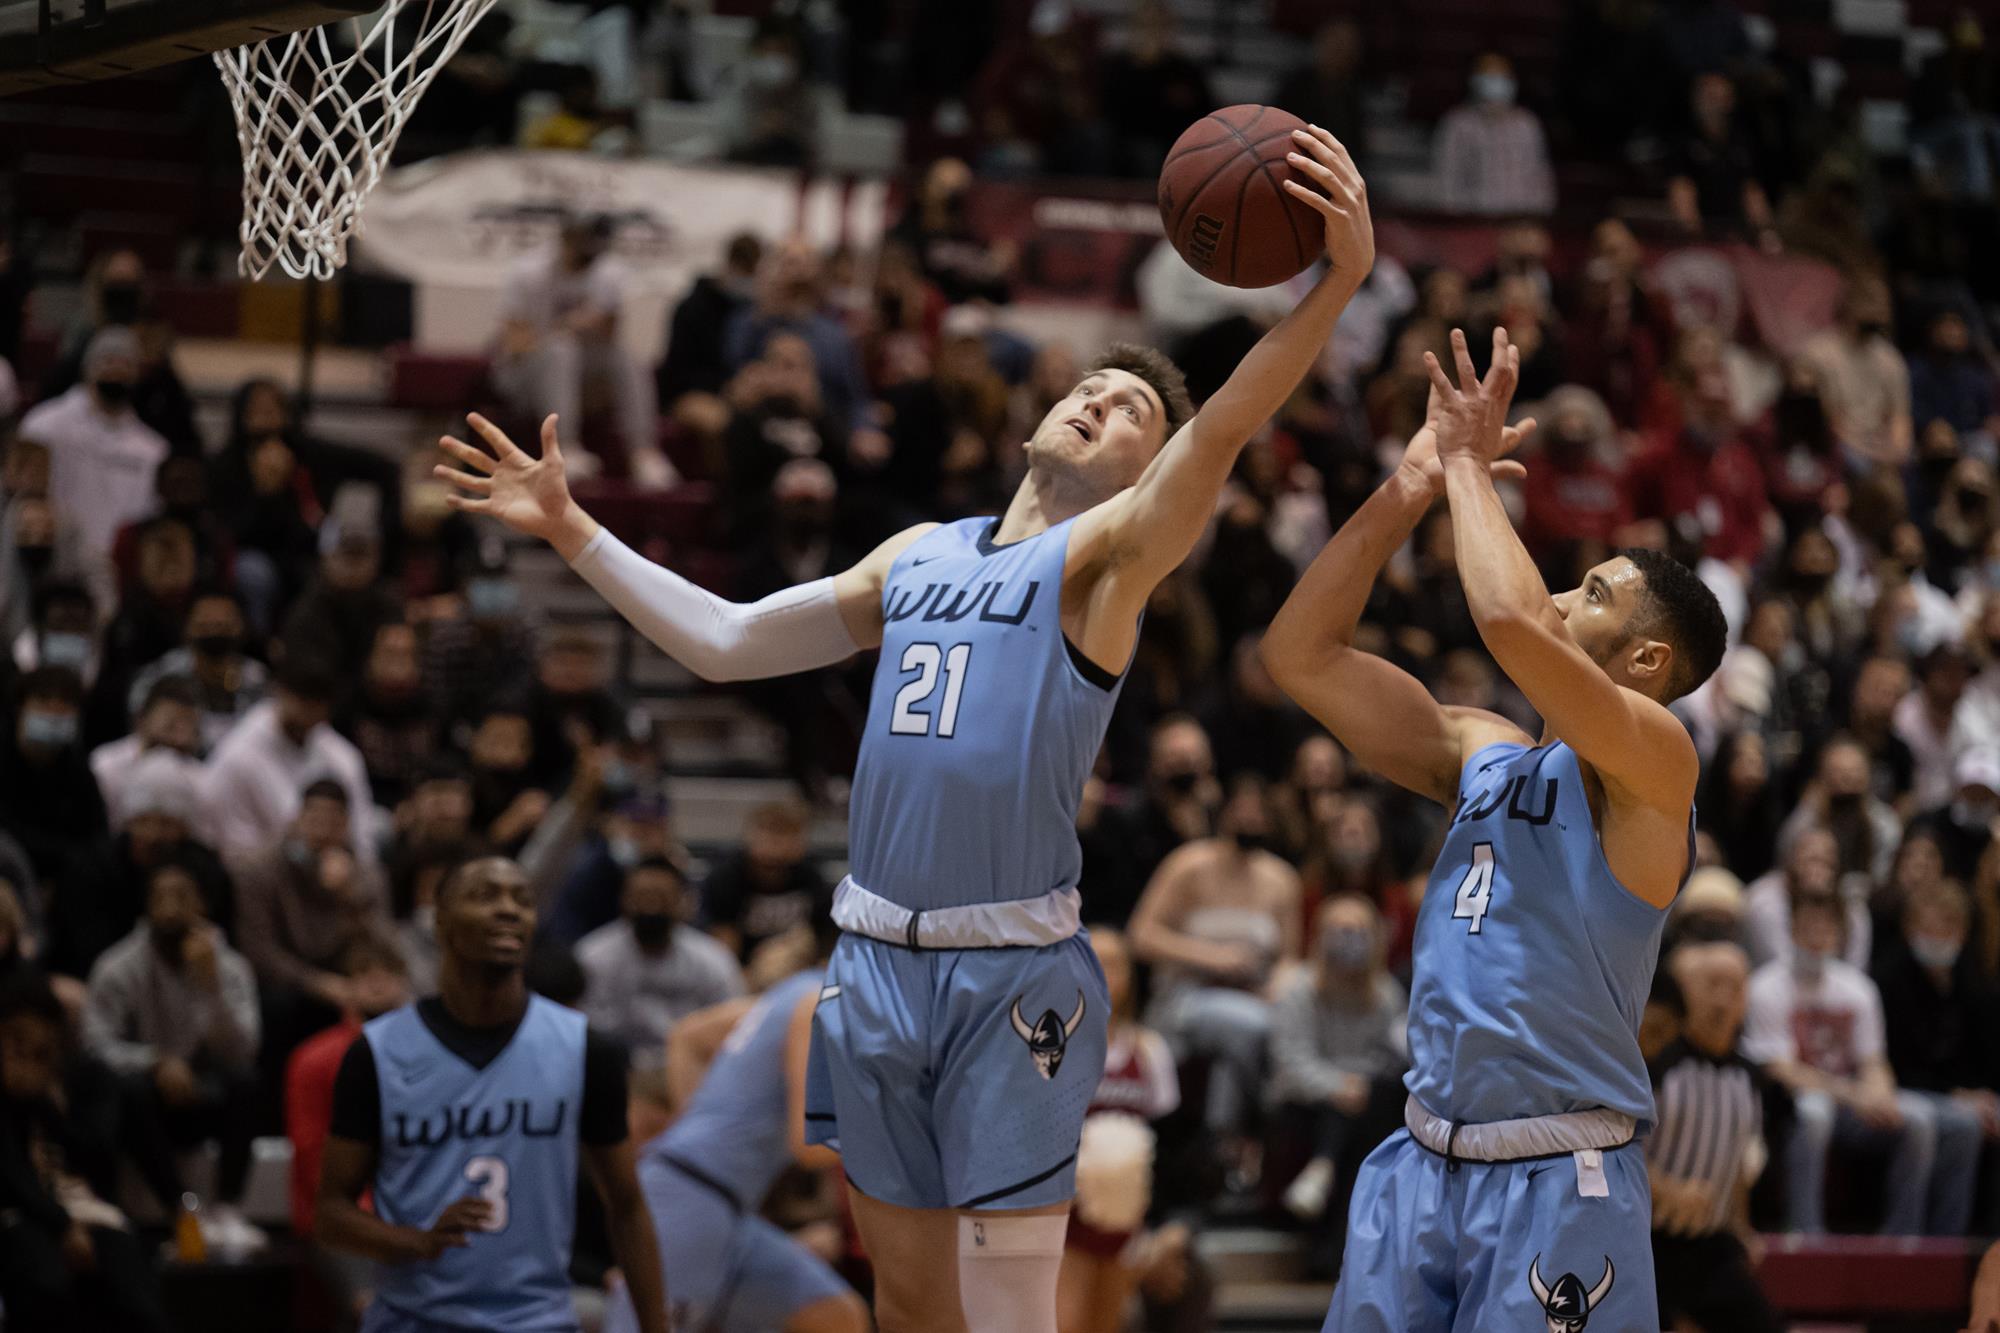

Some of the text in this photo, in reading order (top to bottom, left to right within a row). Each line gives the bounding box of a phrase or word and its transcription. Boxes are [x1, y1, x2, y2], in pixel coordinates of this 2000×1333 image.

[884, 581, 1040, 625] WWU
[890, 641, 973, 739] 21
[1451, 841, 1495, 935] 4
[394, 1100, 565, 1146] WWU
[464, 1155, 510, 1233] 3
